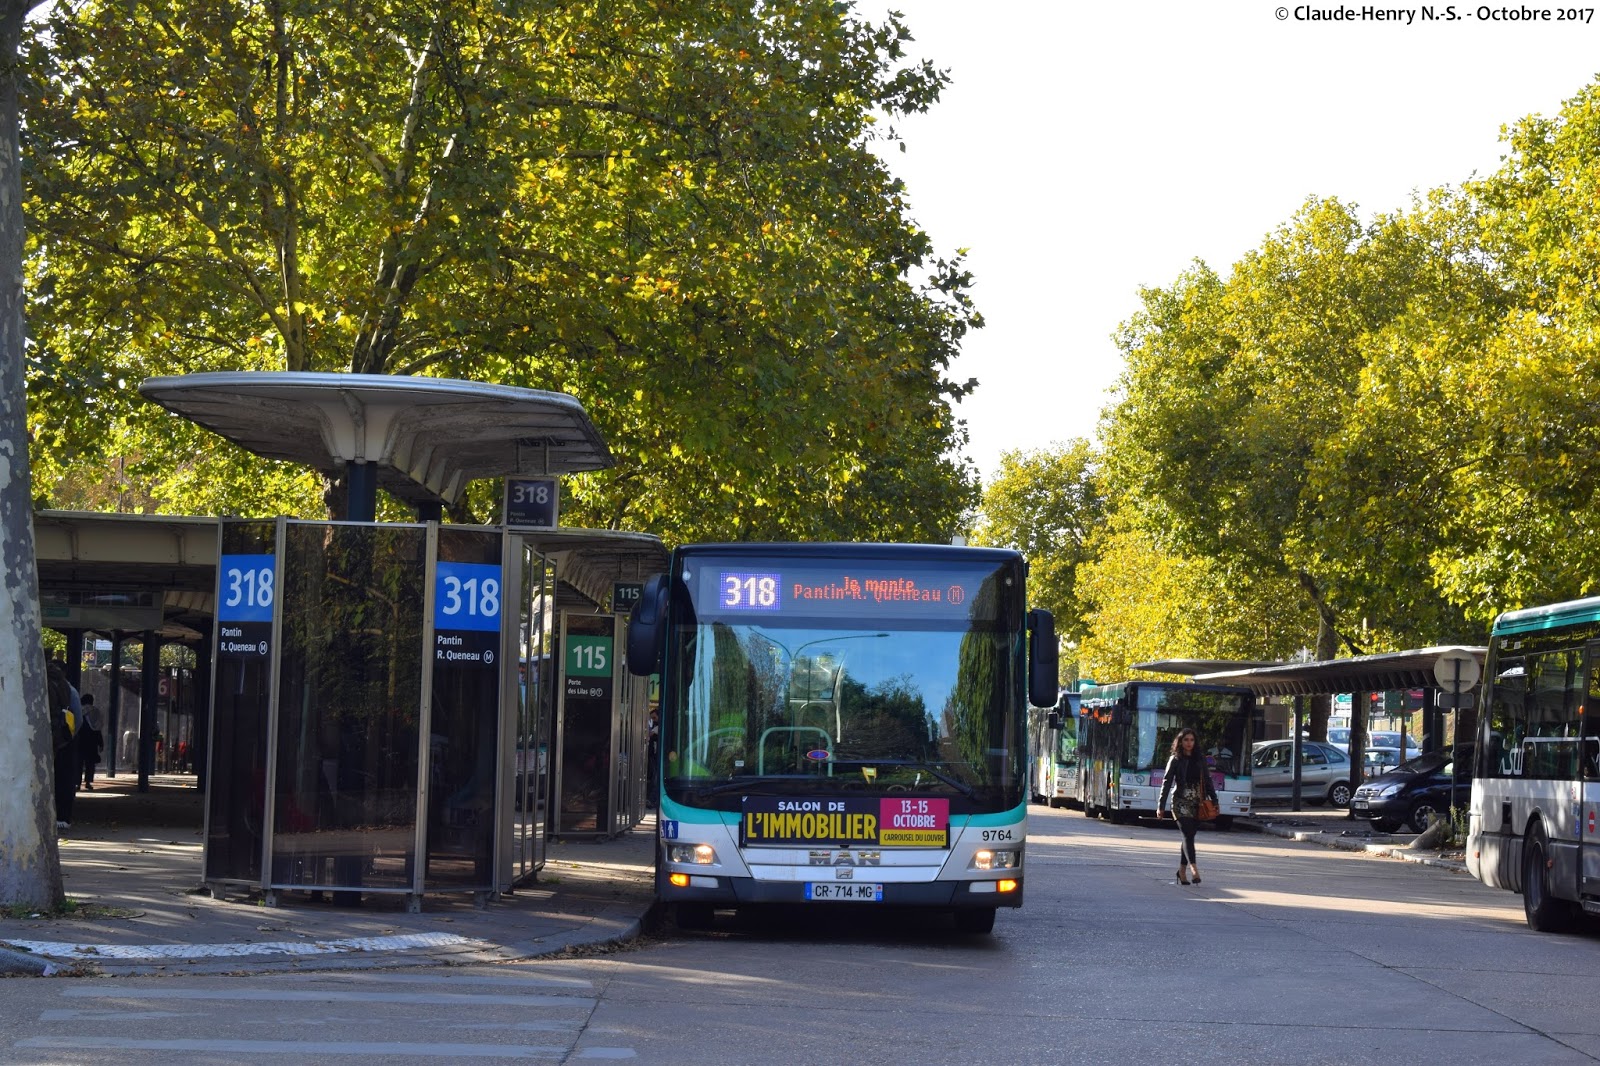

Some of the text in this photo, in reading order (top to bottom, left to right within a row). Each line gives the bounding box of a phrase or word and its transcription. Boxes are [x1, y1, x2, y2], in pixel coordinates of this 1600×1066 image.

[513, 485, 549, 504] 318
[226, 568, 274, 607] 318
[619, 587, 640, 600] 115
[725, 576, 776, 607] 318
[442, 575, 500, 617] 318
[221, 627, 242, 637] Pantin
[437, 635, 463, 645] Pantin
[220, 642, 228, 651] R.
[228, 642, 256, 652] Queneau
[437, 650, 445, 660] R.
[446, 650, 480, 661] Queneau
[573, 645, 606, 670] 115
[567, 687, 577, 695] des
[577, 687, 589, 695] Lilas
[778, 801, 845, 811] SALON DE
[900, 800, 929, 813] 13-15
[747, 812, 877, 839] L'IMMOBILIER
[893, 814, 936, 828] OCTOBRE
[883, 833, 944, 842] CARROUSEL DU LOUVRE
[982, 829, 1012, 842] 9764
[809, 850, 881, 865] MAN
